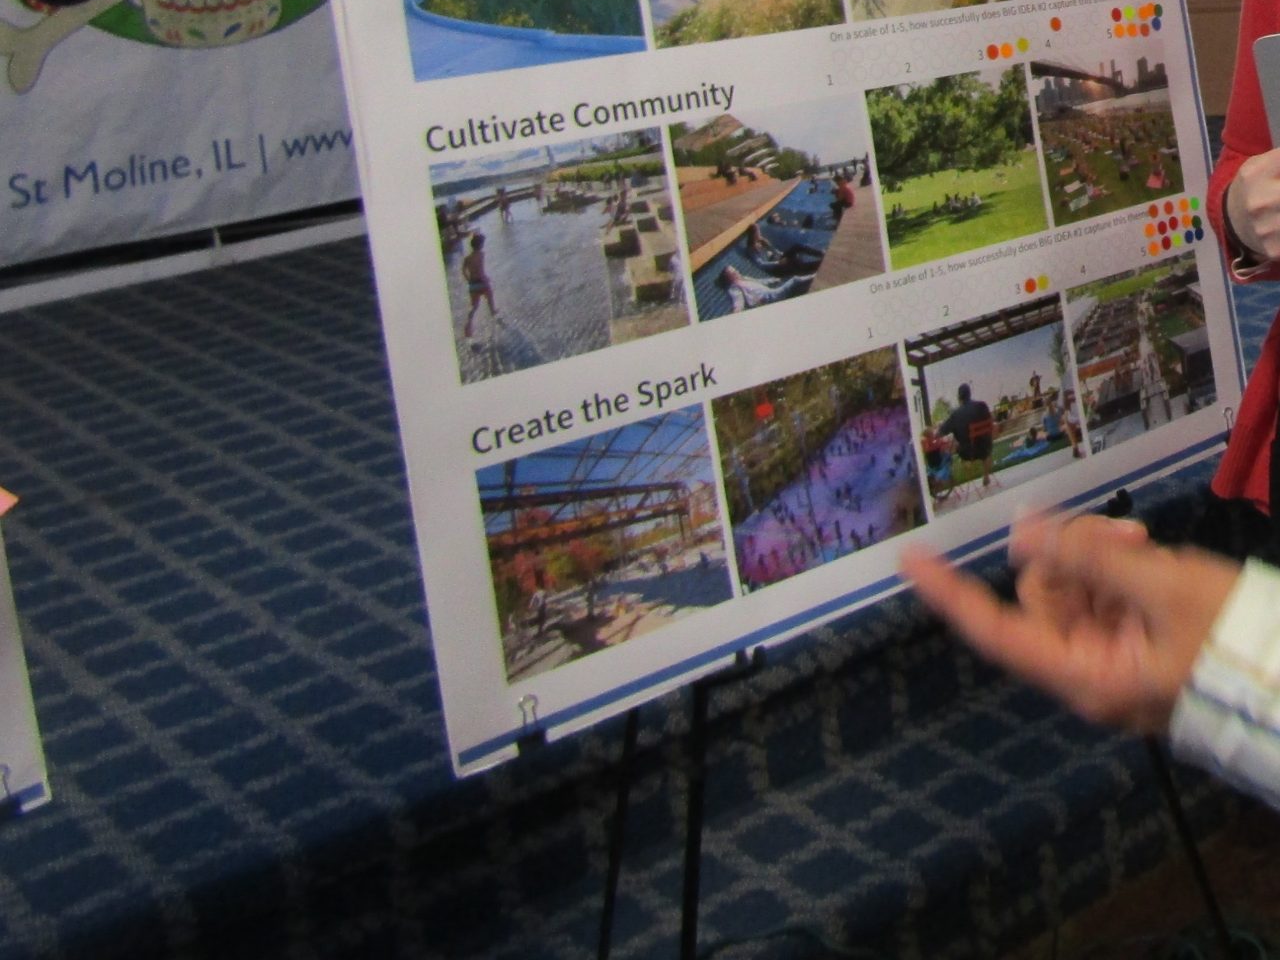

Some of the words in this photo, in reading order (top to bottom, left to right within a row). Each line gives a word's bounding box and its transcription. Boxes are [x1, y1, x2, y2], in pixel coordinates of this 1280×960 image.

[830, 30, 844, 42] On
[846, 32, 852, 40] a
[853, 27, 877, 40] scale
[879, 24, 889, 35] of
[909, 20, 928, 31] how
[981, 8, 1002, 21] does
[904, 62, 912, 73] 2
[426, 110, 565, 152] Cultivate
[573, 82, 735, 128] Community
[8, 173, 48, 209] St
[63, 152, 204, 199] Moline,
[212, 138, 247, 172] IL
[870, 282, 883, 294] On
[885, 281, 891, 290] a
[892, 274, 915, 288] scale
[943, 305, 950, 317] 2
[472, 408, 574, 454] Create
[580, 392, 630, 422] the
[636, 363, 718, 408] Spark
